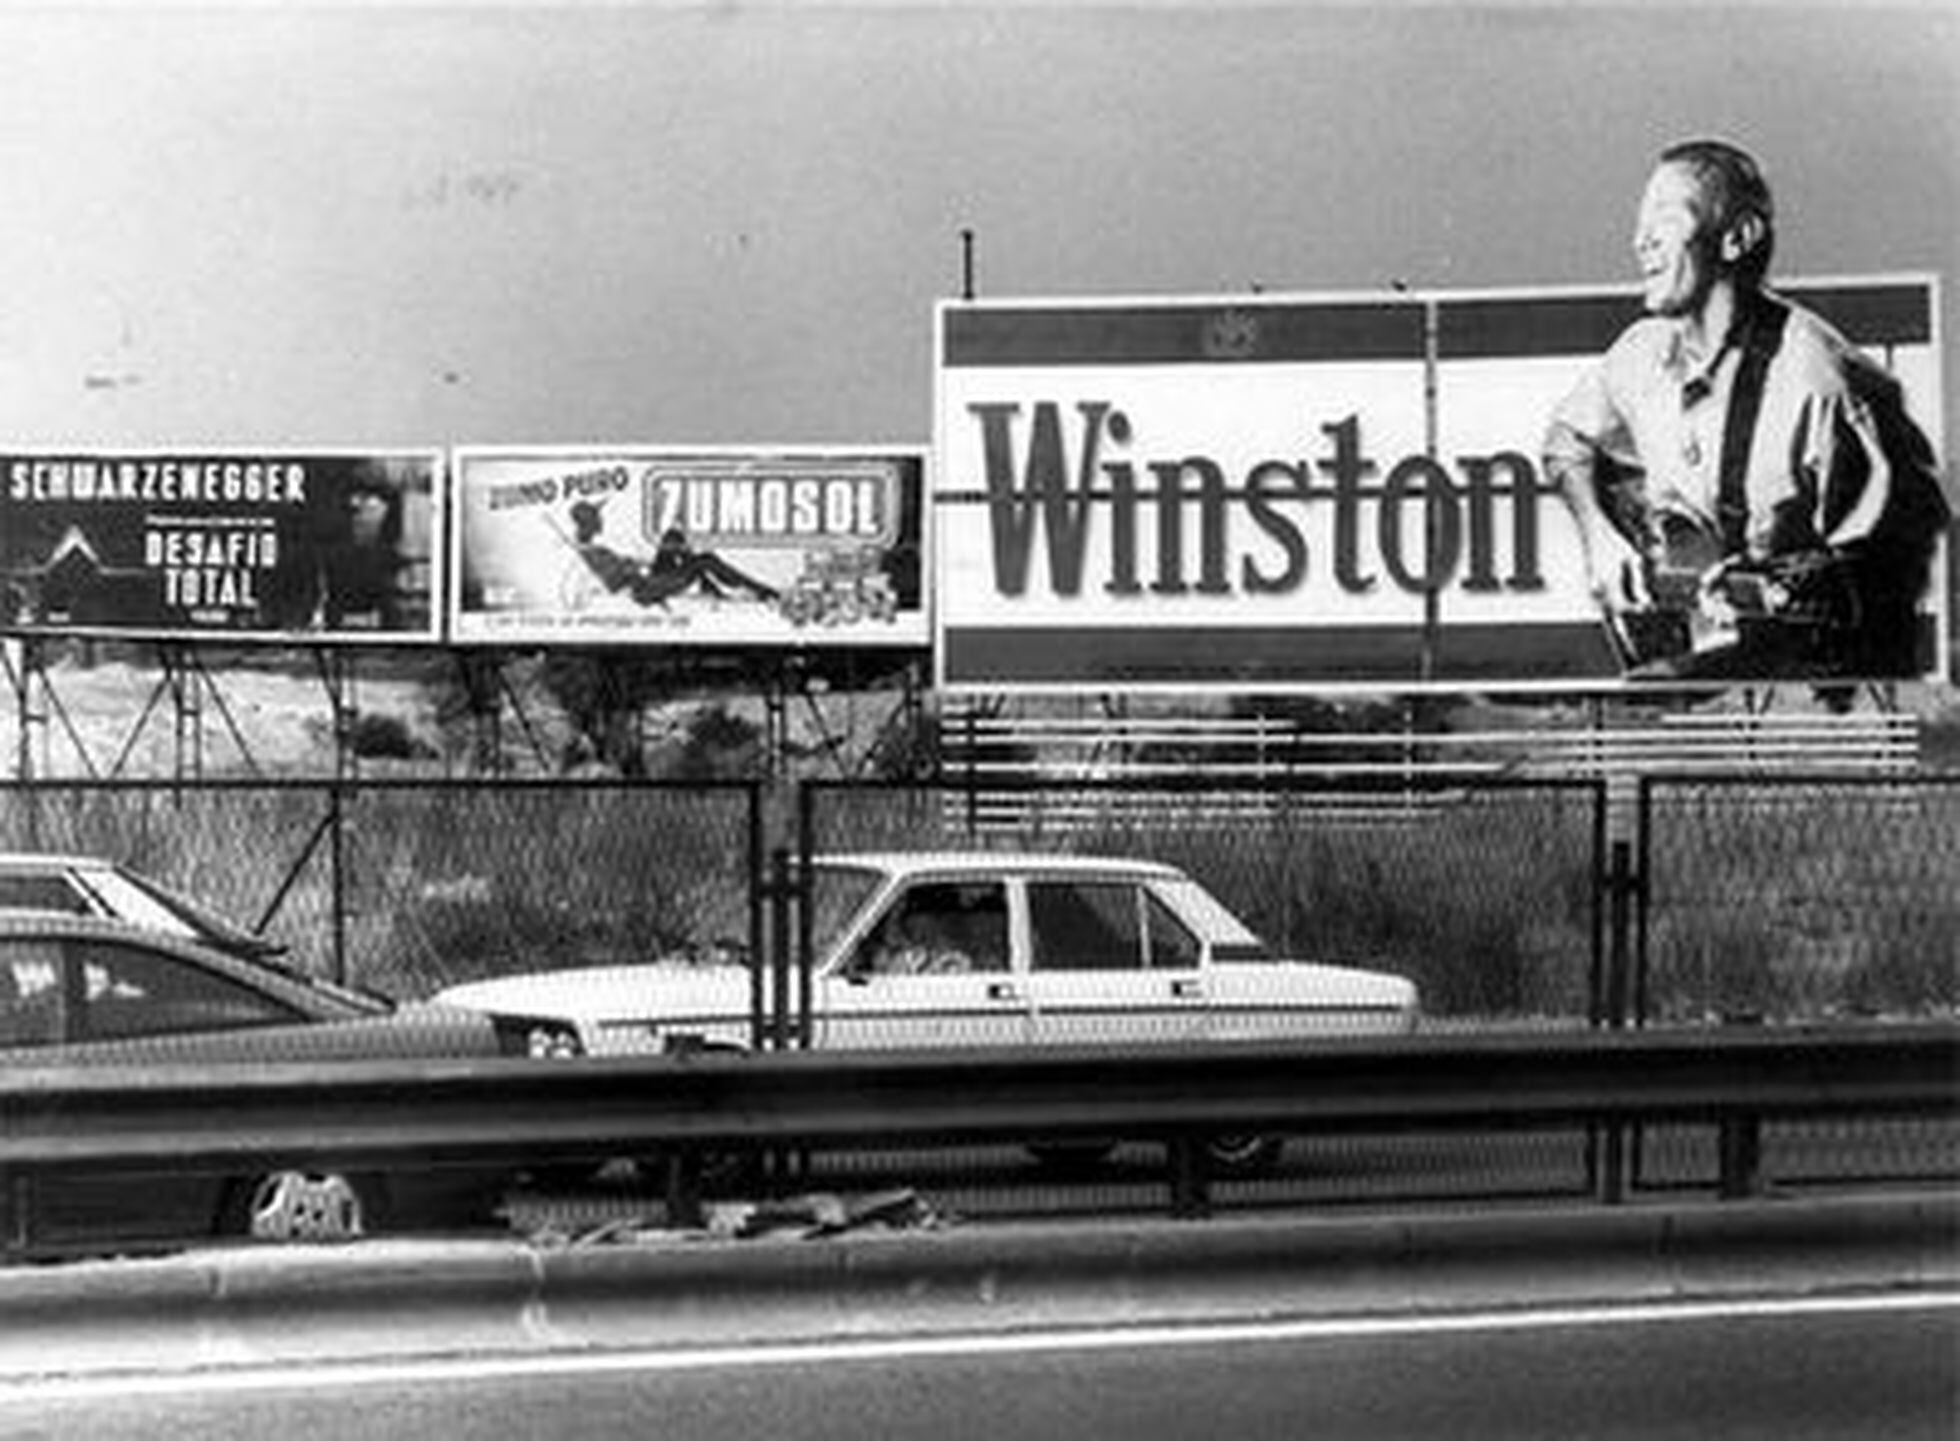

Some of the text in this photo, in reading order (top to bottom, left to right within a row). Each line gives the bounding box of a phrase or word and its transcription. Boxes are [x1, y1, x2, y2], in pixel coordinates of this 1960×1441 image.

[10, 462, 305, 501] SCHWARZENEGGER
[563, 466, 629, 500] PURO
[966, 400, 1545, 598] Winston
[659, 478, 878, 535] ZUMOSOL
[145, 530, 277, 567] DESAFIO
[165, 568, 259, 606] TOTAL
